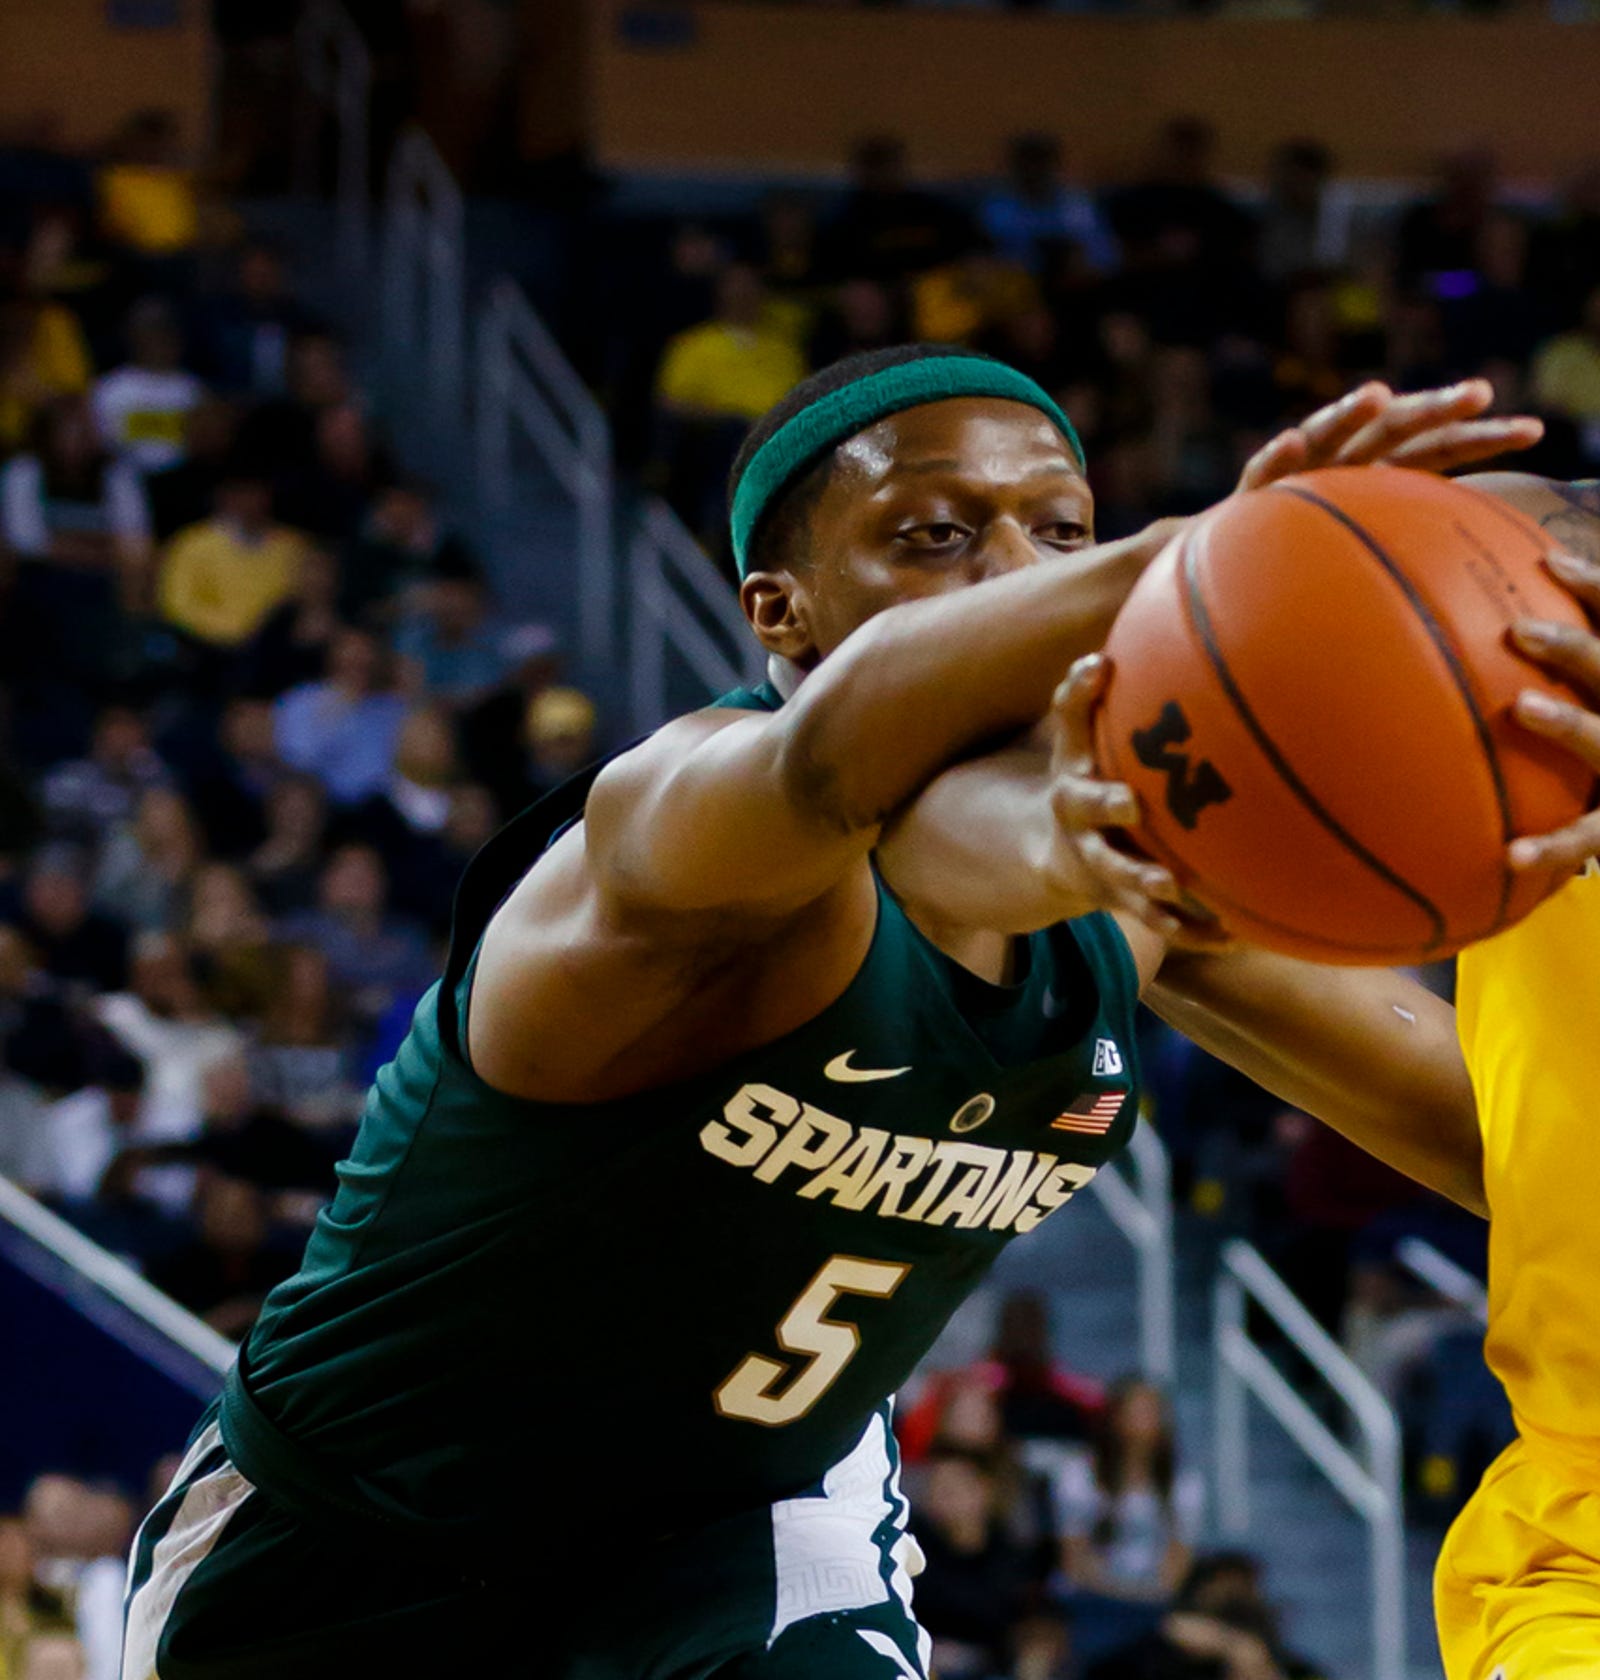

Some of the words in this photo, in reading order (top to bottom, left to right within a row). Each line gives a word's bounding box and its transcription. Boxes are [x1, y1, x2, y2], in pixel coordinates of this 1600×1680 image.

[1131, 700, 1233, 831] M
[700, 1083, 1098, 1233] SPARTANS
[713, 1254, 912, 1428] 5
